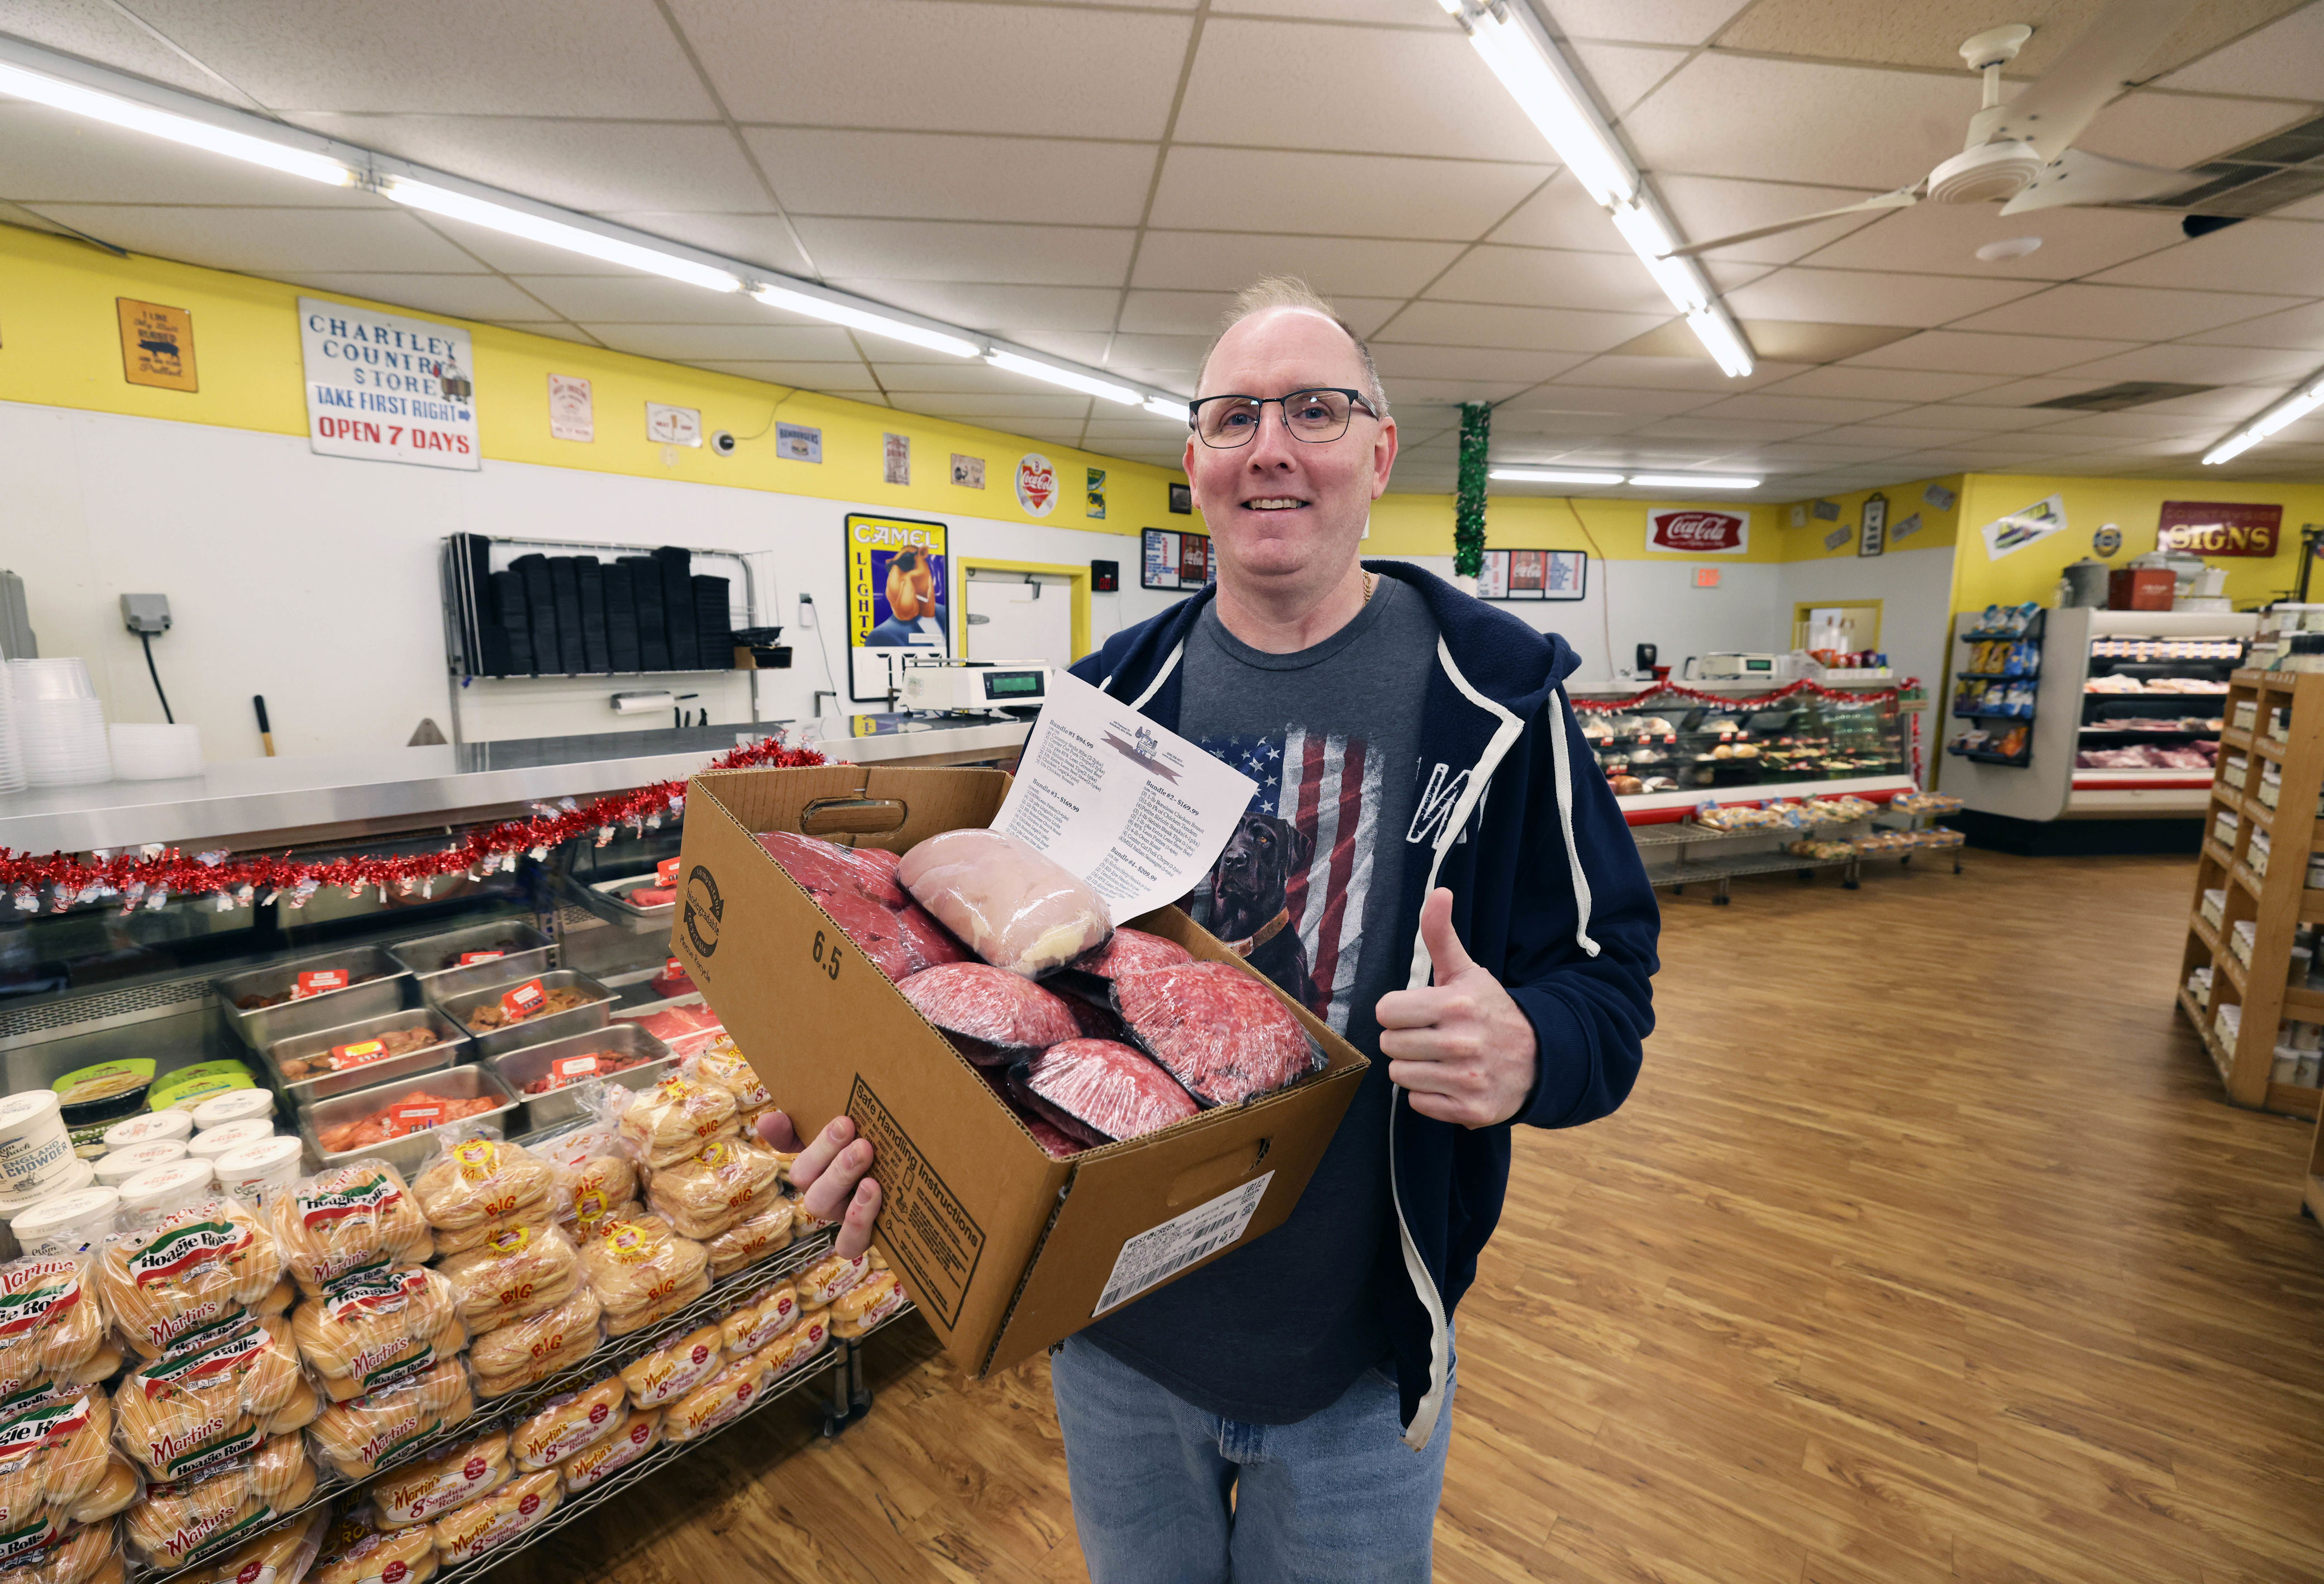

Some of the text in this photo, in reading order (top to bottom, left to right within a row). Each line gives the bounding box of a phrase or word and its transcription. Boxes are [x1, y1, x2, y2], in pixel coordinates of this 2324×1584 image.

[309, 314, 455, 356] CHARTLEY
[354, 368, 438, 395] STORE
[316, 385, 457, 422] TAKE FIRST RIGHT
[319, 417, 470, 454] OPEN 7 DAYS
[854, 523, 939, 550] CAMEL
[1666, 515, 1729, 540] Coca-Cola
[2169, 524, 2271, 551] SIGNS
[856, 552, 870, 644] LIGHTS
[1049, 719, 1068, 734] Bundle
[1075, 734, 1094, 749] $94.99
[1049, 737, 1062, 748] Center
[1069, 750, 1079, 758] Pork
[1042, 757, 1057, 769] Chicken
[1051, 732, 1104, 768] Country Style Ribs (2-2pks)
[1051, 751, 1075, 769] Sirloin Steak
[1046, 765, 1075, 786] Chicken Breasts
[1049, 756, 1078, 777] Extra Lean Beef
[1069, 756, 1079, 764] Lean
[1078, 761, 1093, 774] Ground
[1093, 770, 1102, 779] Beef
[1032, 778, 1080, 813] Bundle #3 $169.99
[1146, 780, 1166, 796] Bundle
[1177, 799, 1199, 816] $169.99
[1027, 815, 1039, 827] Chicken
[1051, 819, 1061, 828] Links
[1053, 814, 1063, 823] Links
[1139, 812, 1148, 820] 1-lb
[1147, 817, 1161, 829] Sirloin
[1161, 826, 1172, 837] Steak
[1172, 833, 1182, 843] Tips
[1147, 794, 1156, 803] 1-lb
[1156, 799, 1174, 814] Boneless
[1173, 811, 1191, 825] Chicken
[1191, 822, 1204, 833] Breast
[1153, 814, 1169, 827] Sirloin
[1162, 812, 1181, 827] Chicken
[1133, 822, 1142, 832] 85%
[1142, 828, 1152, 839] Lean
[1152, 835, 1166, 847] Patties
[1135, 817, 1144, 826] 1-lb
[1151, 827, 1163, 838] Extra
[1162, 834, 1173, 845] Lean
[1172, 841, 1183, 851] Stew
[1182, 848, 1192, 857] Beef
[1138, 833, 1161, 851] Oven Roast
[1111, 846, 1157, 882] Bundle #4 $209.99
[1127, 833, 1170, 867] Center Chops
[1132, 845, 1162, 869] Italian Sausages
[1108, 860, 1130, 879] Sirloin Strip
[696, 869, 720, 916] compostable
[687, 887, 719, 936] biodegradable
[688, 912, 706, 953] recyclable
[680, 934, 711, 983] Please Recycle
[812, 930, 843, 980] 6.5
[755, 1088, 763, 1102] 8
[696, 1119, 719, 1138] BIG
[2, 1141, 59, 1169] ENGLAND
[6, 1141, 68, 1177] CHOWDER
[856, 1081, 877, 1118] Safe
[876, 1109, 918, 1172] Handling
[918, 1163, 979, 1250] Instructions
[484, 1195, 517, 1218] BIG
[729, 1188, 753, 1208] BIG
[141, 1234, 199, 1268] Hoagie
[741, 1235, 766, 1254] BIG
[313, 1249, 369, 1283] Martin's
[499, 1284, 533, 1305] BIG
[647, 1278, 675, 1301] BIG
[827, 1283, 835, 1298] 8
[149, 1301, 216, 1346] Martin's
[870, 1309, 878, 1324] 8
[353, 1338, 408, 1379] Martin's
[530, 1333, 564, 1361] BIG
[407, 1357, 430, 1373] Rolls
[643, 1361, 676, 1394] Martin's
[657, 1381, 668, 1399] 8
[688, 1399, 721, 1430] Martin's
[699, 1418, 711, 1433] 8
[150, 1419, 223, 1466] Martin's
[361, 1418, 416, 1463] Martin's
[527, 1423, 568, 1458] Martin's
[545, 1425, 599, 1463] 8 Sandwich
[569, 1437, 591, 1452] Rolls
[178, 1439, 254, 1476] Hoagie Rolls
[574, 1444, 612, 1479] Martin's
[590, 1466, 602, 1481] 8
[394, 1476, 441, 1510] Martin's
[410, 1482, 475, 1518] 8 Sandwich
[438, 1494, 464, 1509] Rolls
[8, 1533, 45, 1554] Rolls
[165, 1505, 235, 1557] Martin's
[452, 1517, 496, 1556] Martin's
[470, 1516, 530, 1557] 8 Sandwich
